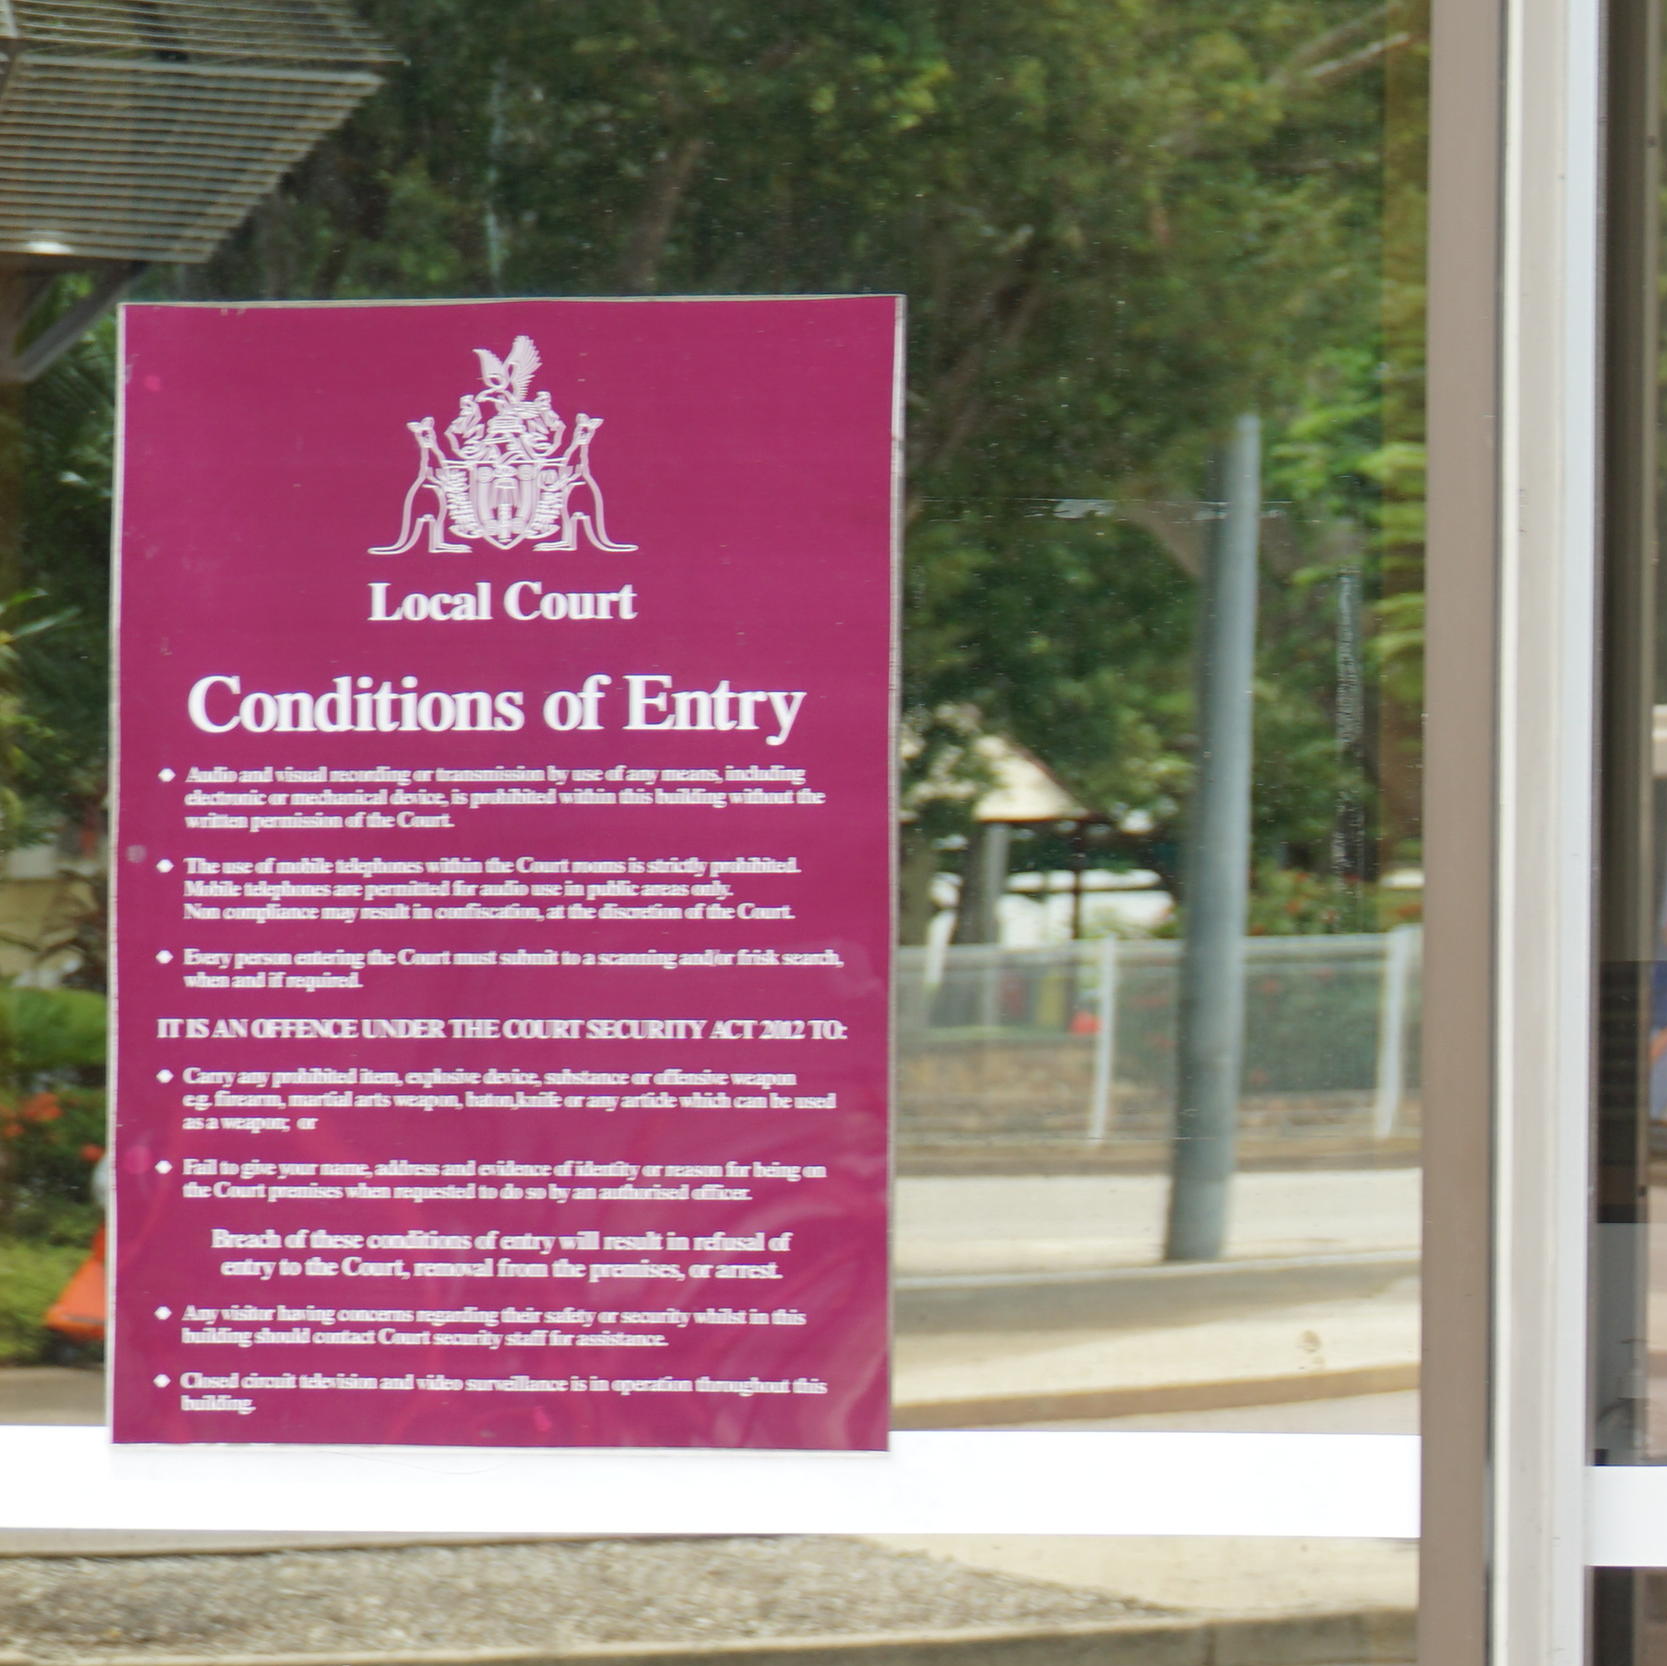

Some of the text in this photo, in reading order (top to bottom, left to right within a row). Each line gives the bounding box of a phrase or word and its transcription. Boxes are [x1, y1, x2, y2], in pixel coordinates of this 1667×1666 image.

[368, 581, 638, 621] Local Court
[187, 674, 807, 746] Conditions of Entry
[186, 767, 237, 783] Audio
[238, 767, 273, 782] and
[275, 766, 328, 782] visual
[329, 766, 411, 786] recording
[413, 770, 434, 781] or
[434, 766, 545, 781] transmission
[547, 766, 570, 785] by
[571, 770, 603, 781] use
[605, 765, 626, 781] of
[626, 770, 659, 785] any
[725, 765, 805, 785] including
[184, 790, 267, 805] electronic
[268, 794, 290, 805] or
[290, 789, 388, 805] mechanical
[451, 789, 468, 804] is
[470, 788, 556, 808] prohibited
[559, 788, 616, 804] within
[619, 788, 653, 804] this
[655, 788, 727, 808] building
[728, 788, 794, 804] without
[796, 788, 825, 804] the
[185, 813, 248, 828] written
[250, 812, 343, 832] permission
[345, 812, 366, 828] of
[366, 812, 395, 828] the
[184, 858, 220, 874] The
[222, 862, 253, 874] use
[255, 858, 276, 874] of
[276, 858, 334, 874] mobile
[335, 858, 425, 878] telephones
[425, 858, 483, 873] within
[485, 857, 514, 873] the
[516, 857, 570, 873] Court
[571, 862, 626, 873] rooms
[628, 858, 645, 873] is
[647, 857, 708, 877] strictly
[184, 881, 242, 896] Mobile
[244, 881, 332, 900] telephones
[332, 885, 363, 896] are
[365, 880, 450, 900] permitted
[452, 880, 479, 896] for
[479, 880, 529, 896] audio
[531, 885, 562, 896] use
[564, 880, 584, 896] in
[587, 880, 640, 900] public
[640, 885, 689, 896] areas
[157, 1019, 847, 1039] IT IS AN OFFENCE UNDER THE COURT SECURITY ACT 2012 TO:
[212, 1229, 793, 1254] Breach of these conditions of entry will result in refusal of
[221, 1259, 276, 1280] entry
[279, 1259, 302, 1275] to
[304, 1257, 339, 1276] the
[414, 1258, 493, 1277] removal
[497, 1258, 548, 1277] from
[552, 1259, 586, 1277] the
[688, 1265, 714, 1278] or
[182, 1328, 253, 1347] building
[254, 1328, 311, 1344] should
[312, 1331, 376, 1344] contact
[378, 1328, 431, 1344] Court
[431, 1330, 504, 1349] security
[505, 1330, 549, 1346] staff
[549, 1330, 575, 1346] for
[180, 1372, 827, 1396] Closed circuit television and video surveillance is in operation throughout this
